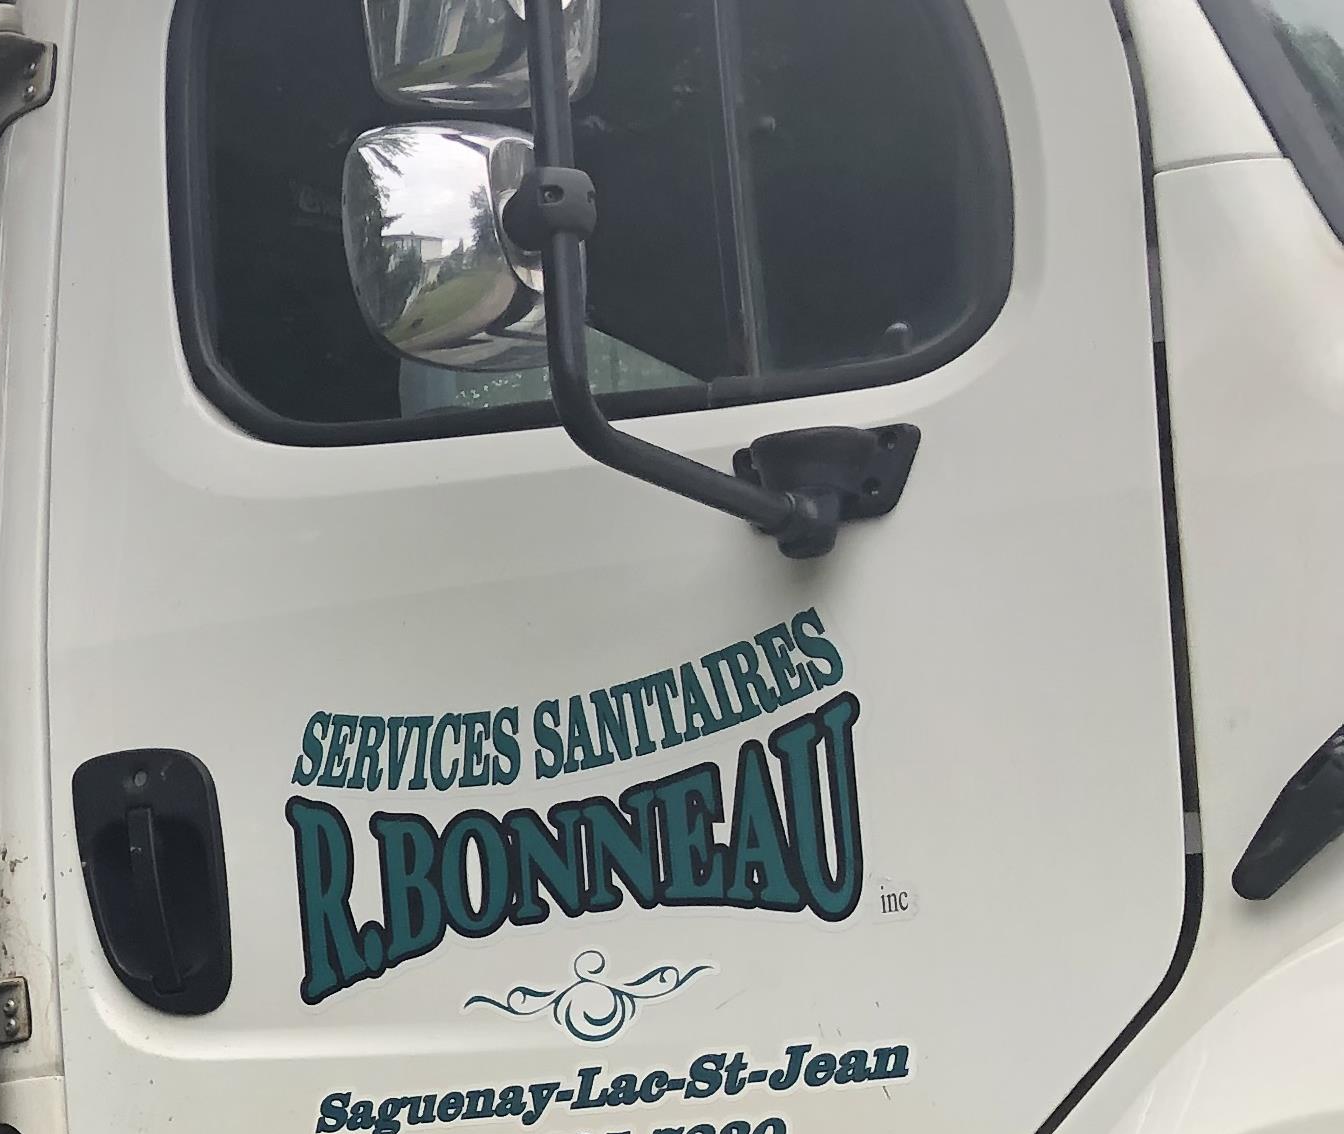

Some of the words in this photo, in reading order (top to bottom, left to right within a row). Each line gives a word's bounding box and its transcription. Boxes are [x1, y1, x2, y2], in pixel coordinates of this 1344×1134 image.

[292, 706, 520, 790] SERVICES
[534, 606, 844, 782] SANITAIRES
[880, 885, 909, 913] inc
